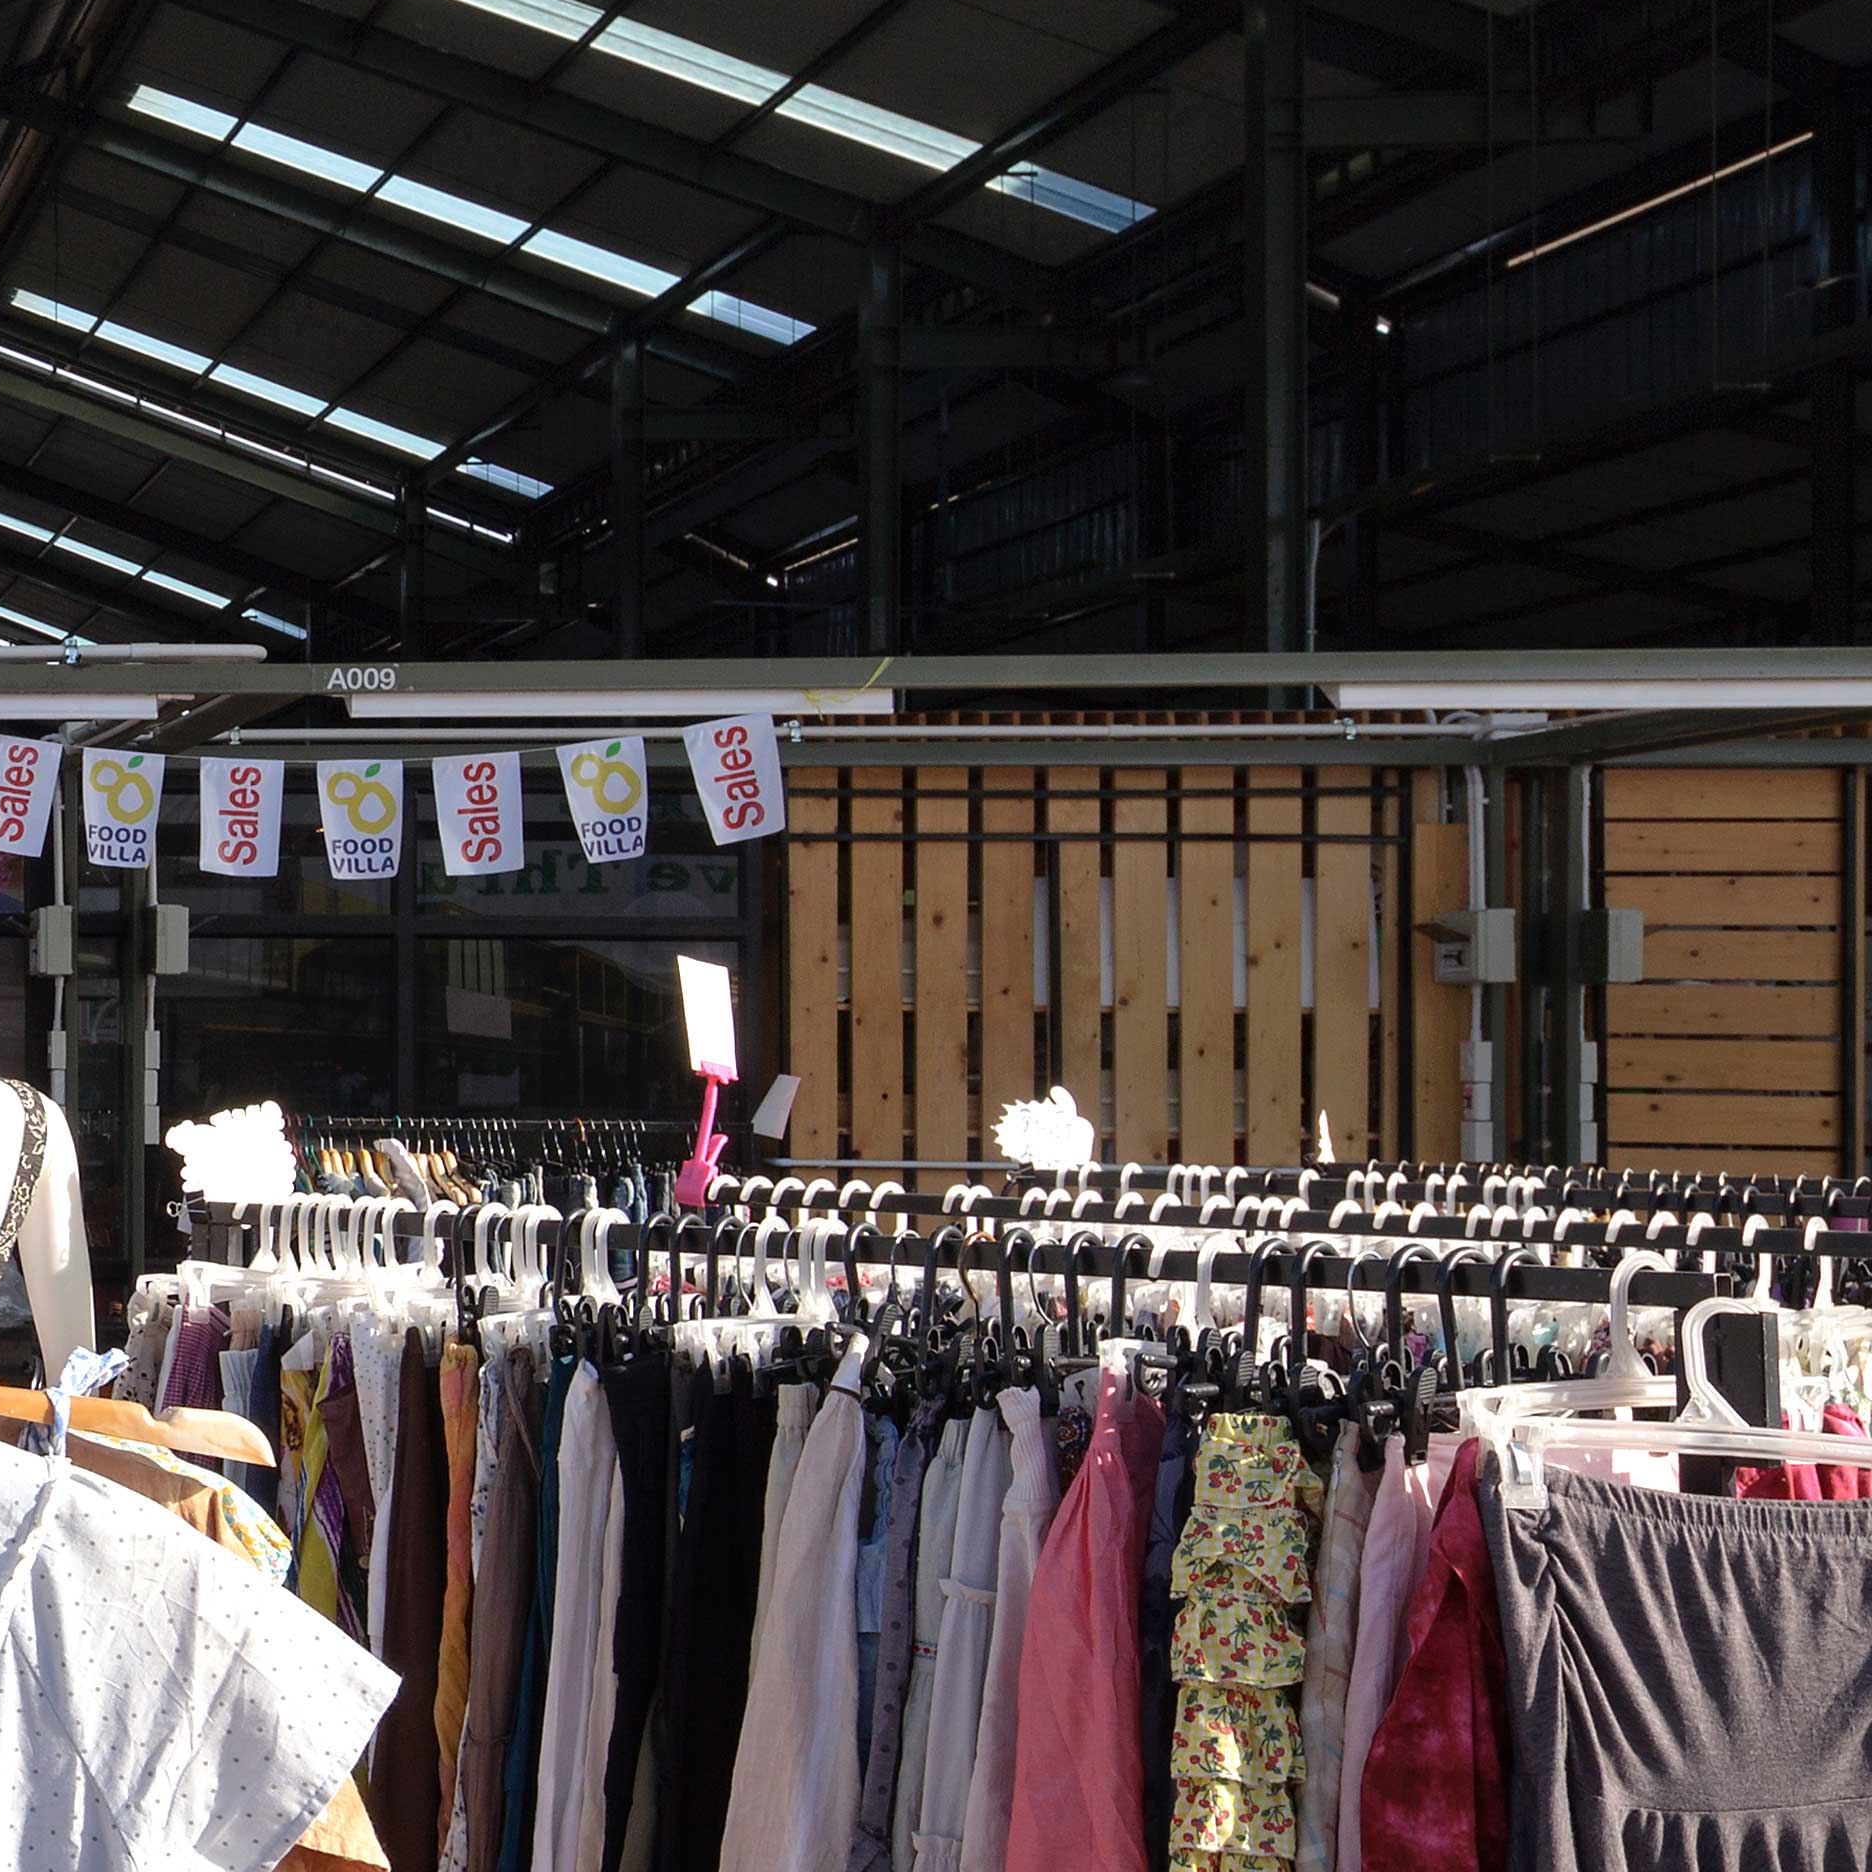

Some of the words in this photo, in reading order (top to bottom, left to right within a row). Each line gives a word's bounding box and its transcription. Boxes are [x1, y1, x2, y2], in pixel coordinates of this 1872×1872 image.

[326, 667, 396, 690] A009
[714, 725, 766, 831] Sales
[218, 766, 262, 866] Sales
[457, 760, 503, 864] Sales
[88, 824, 147, 844] FOOD
[581, 816, 642, 838] FOOD
[88, 841, 147, 863] VILLA
[332, 837, 394, 855] FOOD
[584, 833, 644, 858] VILLA
[333, 855, 396, 874] VILLA
